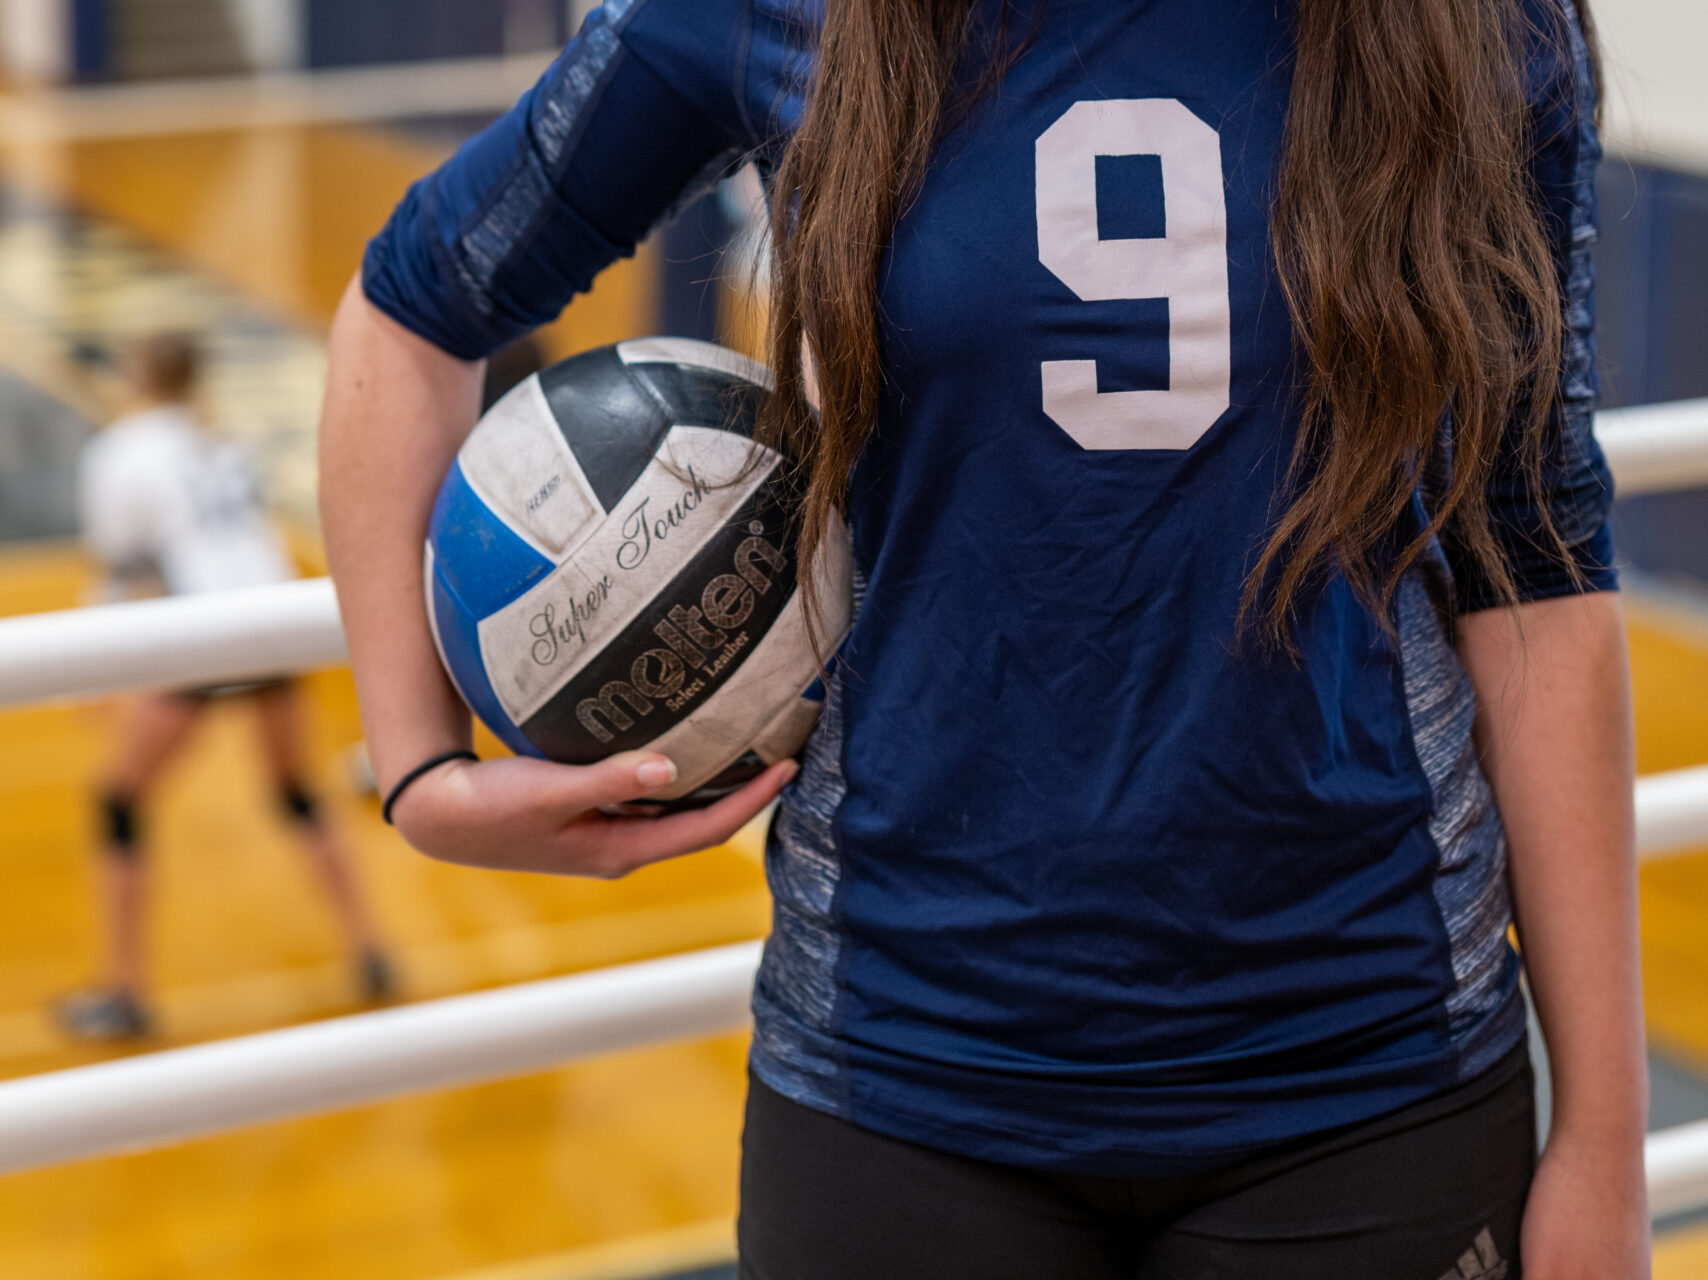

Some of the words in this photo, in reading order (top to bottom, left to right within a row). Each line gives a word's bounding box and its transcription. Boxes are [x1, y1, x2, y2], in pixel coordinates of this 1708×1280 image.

[1035, 98, 1230, 450] 9
[530, 574, 613, 666] Super
[616, 465, 711, 570] Touch
[575, 536, 786, 742] molten
[665, 678, 706, 712] Select
[702, 630, 750, 677] Leather
